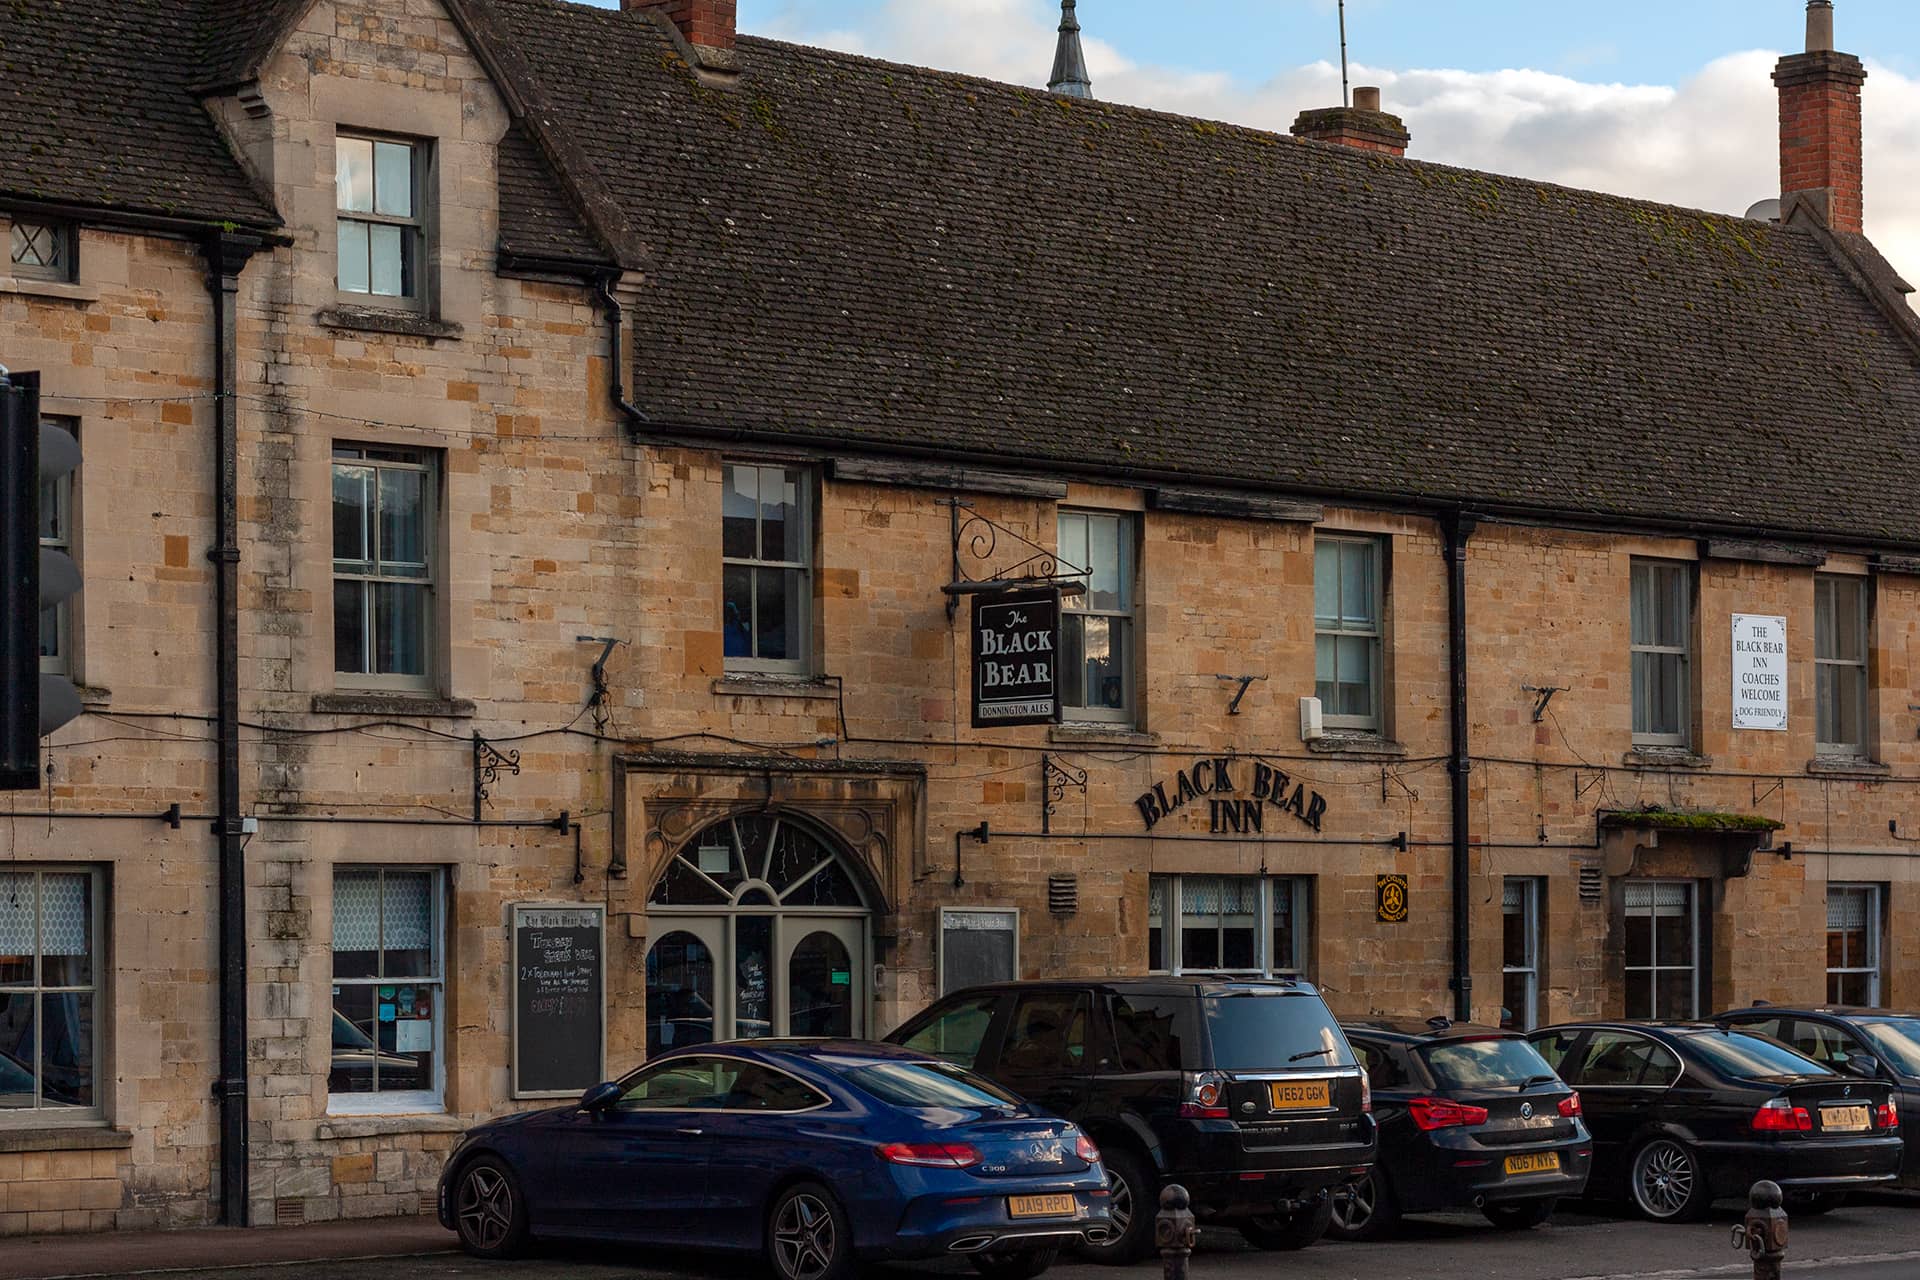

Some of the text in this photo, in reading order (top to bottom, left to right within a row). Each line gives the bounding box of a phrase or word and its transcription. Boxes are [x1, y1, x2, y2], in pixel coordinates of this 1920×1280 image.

[1005, 611, 1027, 628] The
[1752, 626, 1767, 638] THE
[980, 629, 1053, 655] BLACK
[1736, 640, 1784, 654] BLACK BEAR
[1752, 657, 1768, 668] INN
[984, 662, 1051, 686] BEAR
[1742, 672, 1780, 685] COACHES
[1741, 688, 1780, 701] WELCOME
[983, 703, 1049, 717] DONNINGTON ALES
[1739, 707, 1782, 718] DOG FRIENDLY
[1135, 758, 1327, 832] BLACK BEAR
[1208, 799, 1263, 834] INN
[1278, 1087, 1304, 1101] VE62
[1018, 1199, 1043, 1212] DA19
